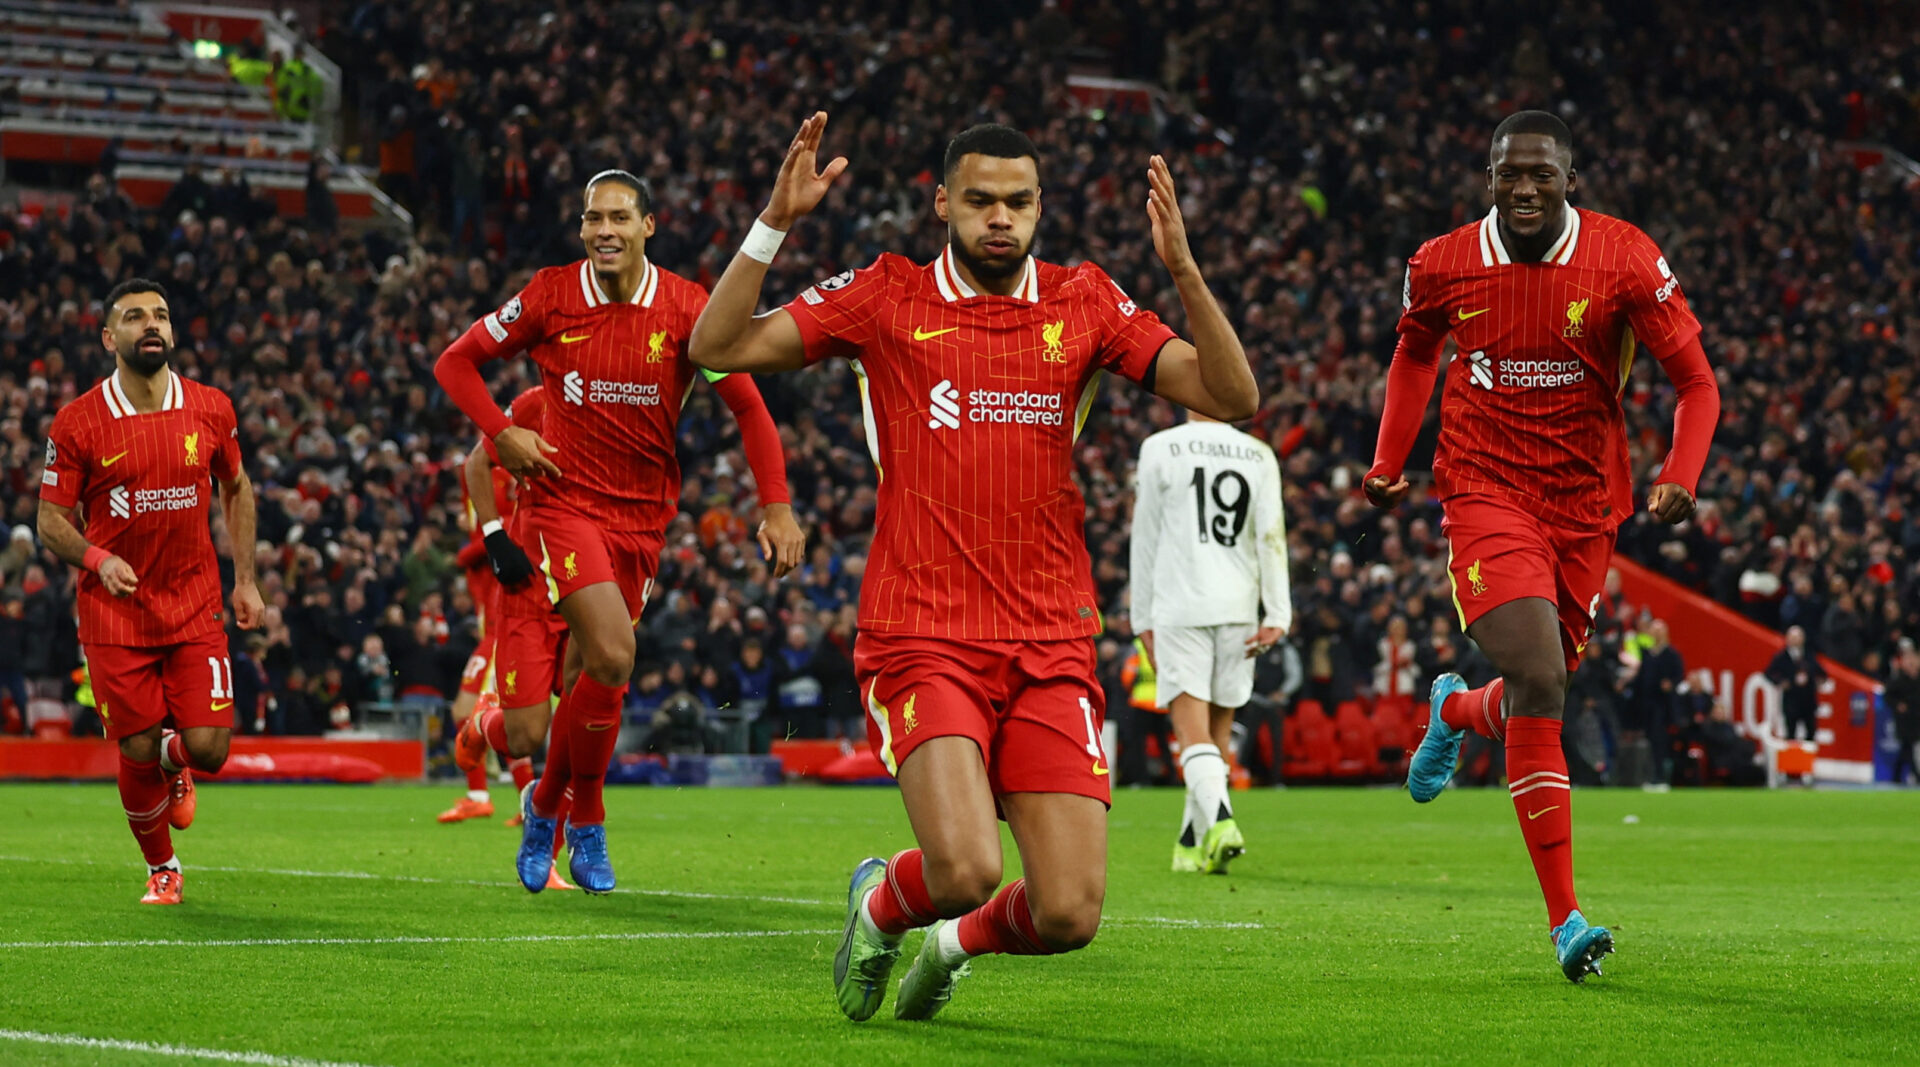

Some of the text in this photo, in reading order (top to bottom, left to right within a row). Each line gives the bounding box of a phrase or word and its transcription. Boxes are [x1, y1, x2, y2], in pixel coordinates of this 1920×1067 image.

[1499, 358, 1580, 373] standard
[589, 379, 658, 395] standard
[1499, 369, 1584, 388] chartered
[588, 391, 660, 406] chartered
[968, 388, 1061, 409] standard
[968, 405, 1063, 426] chartered
[1188, 440, 1265, 463] CEBALLOS
[134, 483, 196, 502] standard
[134, 494, 198, 513] chartered
[1189, 467, 1251, 547] 19
[207, 656, 234, 699] 11
